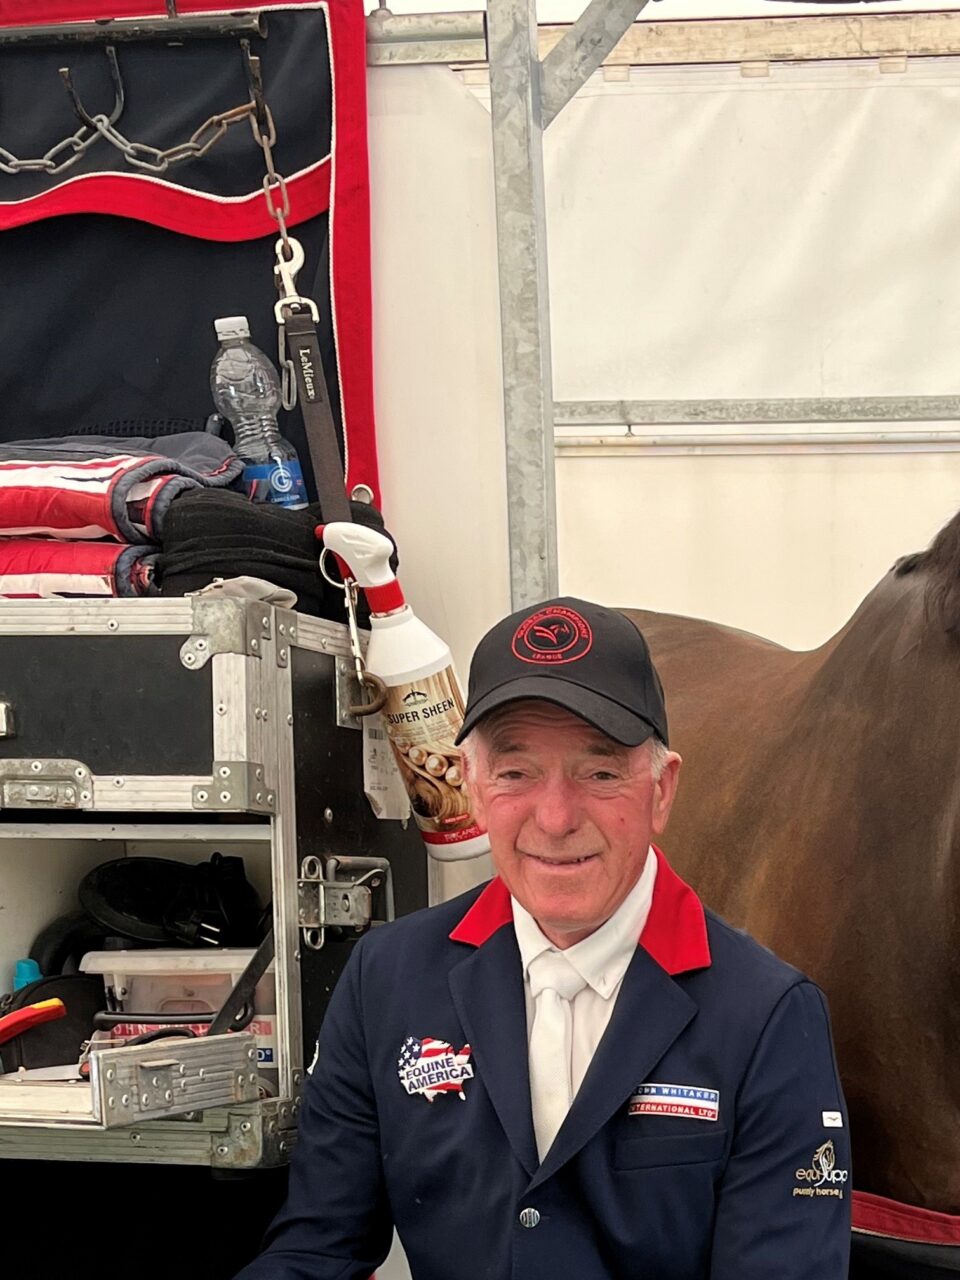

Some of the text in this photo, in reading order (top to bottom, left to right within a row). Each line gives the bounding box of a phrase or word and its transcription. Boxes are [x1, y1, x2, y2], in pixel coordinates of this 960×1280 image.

[299, 348, 316, 399] LeMieux
[387, 710, 421, 725] SUPER
[423, 697, 456, 720] SHEEN
[406, 1057, 455, 1080] EQUINE
[408, 1066, 471, 1092] AMERICA
[661, 1087, 717, 1100] WHITAKER
[630, 1103, 696, 1115] TERNATIONAL
